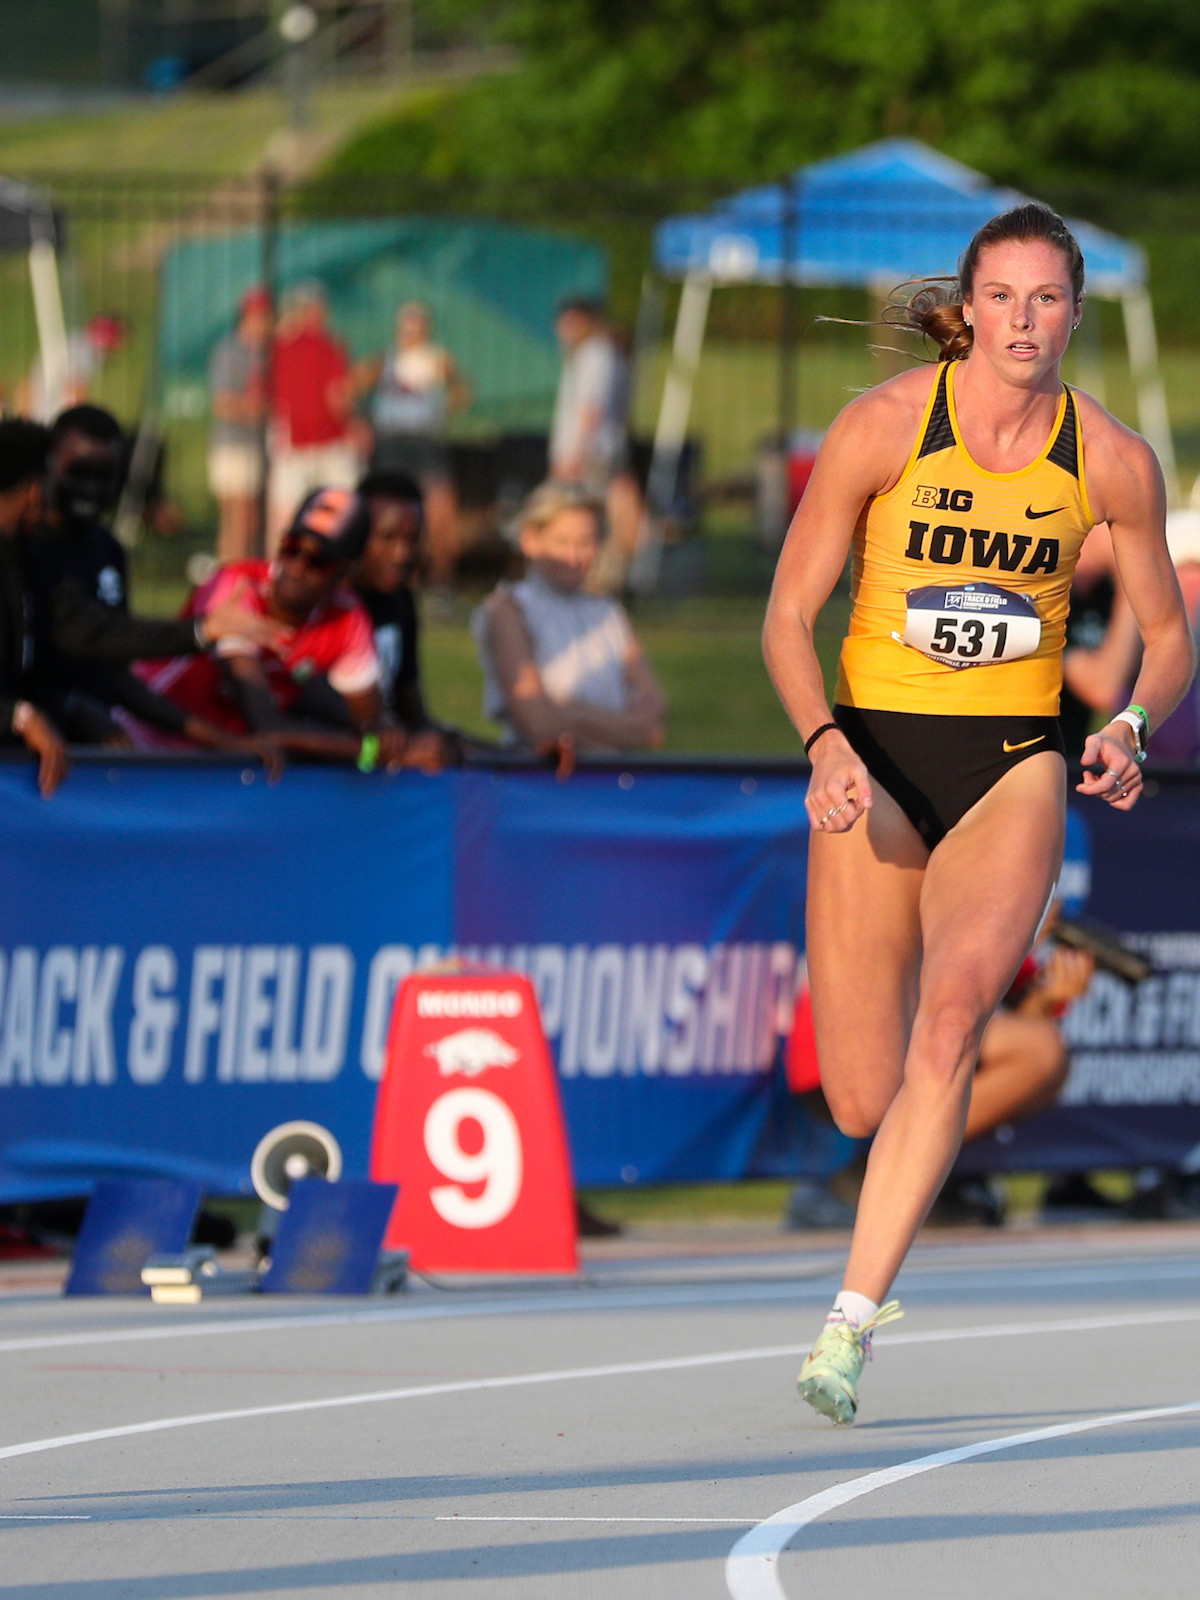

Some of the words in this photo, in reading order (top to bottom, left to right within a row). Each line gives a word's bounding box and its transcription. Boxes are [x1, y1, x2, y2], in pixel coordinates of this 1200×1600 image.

[905, 520, 1060, 575] IOWA
[930, 617, 1008, 658] 531
[0, 943, 126, 1087] ACK
[127, 943, 182, 1086] &
[184, 942, 356, 1083] FIELD
[360, 941, 808, 1080] CPIONSHIP
[416, 990, 524, 1019] MONDO
[422, 1085, 524, 1230] 9
